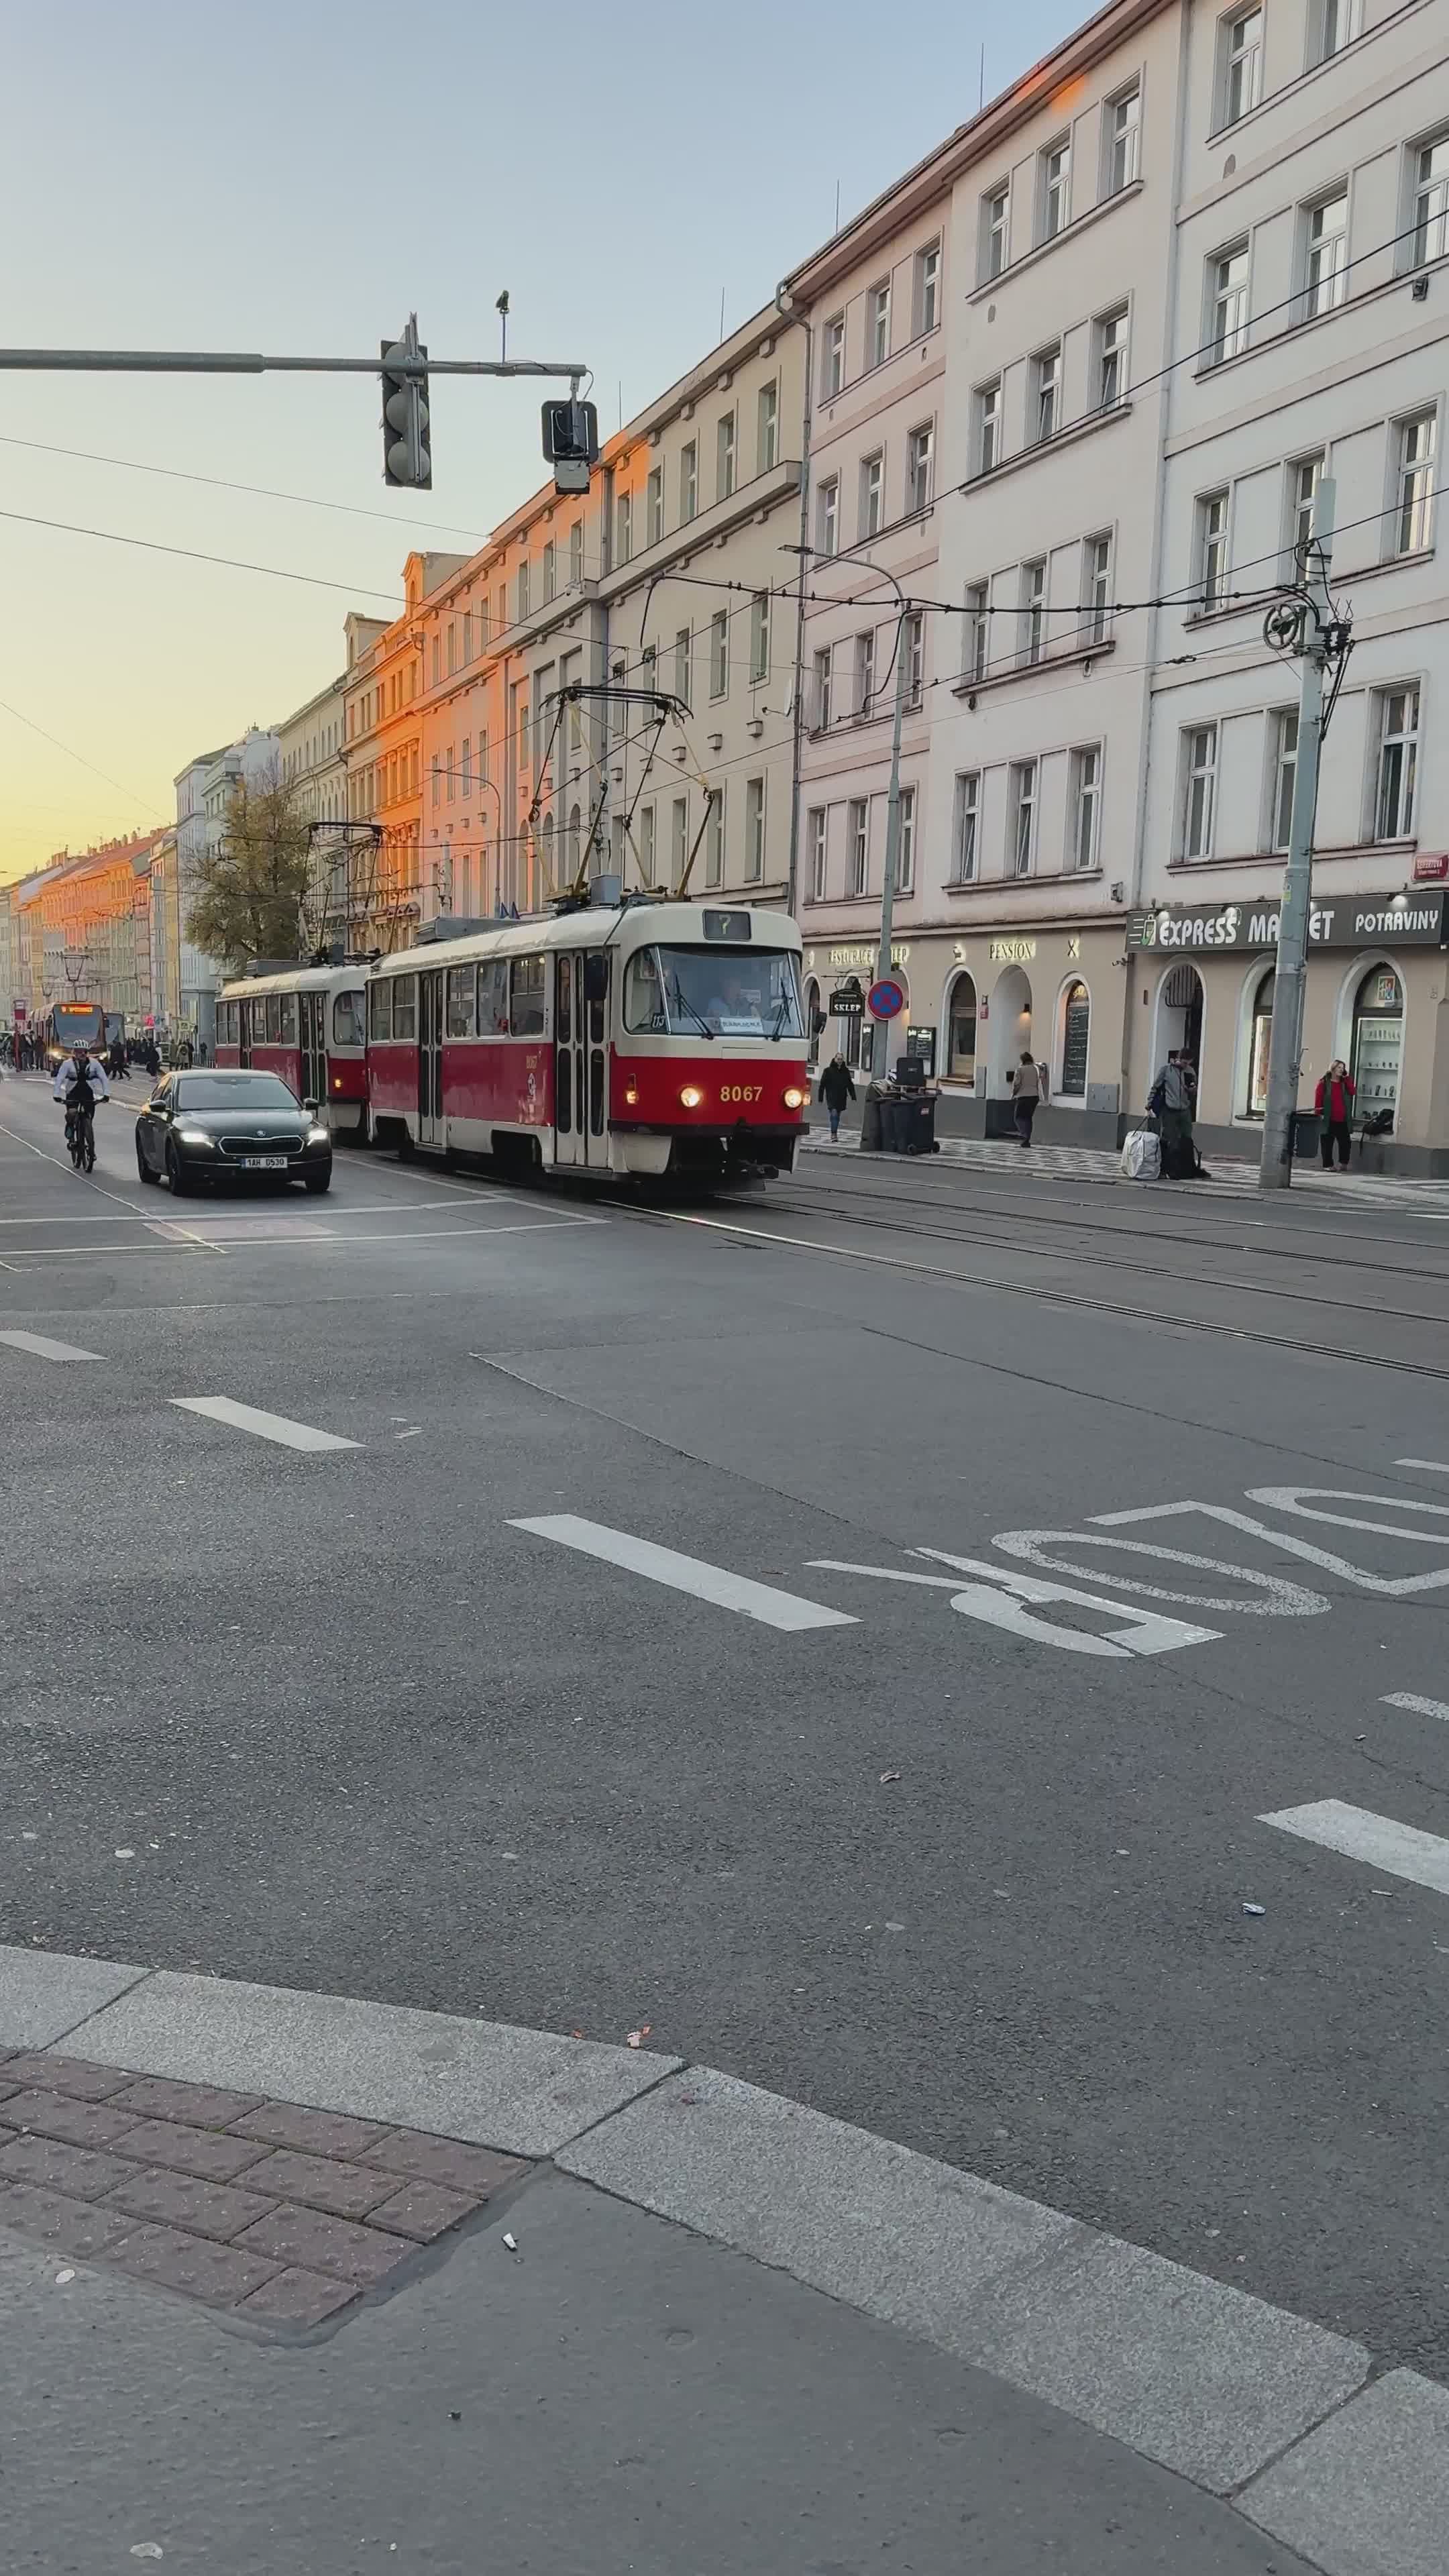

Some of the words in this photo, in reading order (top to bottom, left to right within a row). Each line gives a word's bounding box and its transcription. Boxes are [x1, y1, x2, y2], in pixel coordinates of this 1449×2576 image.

[718, 914, 731, 934] 7
[1159, 917, 1238, 946] EXPRESS
[1248, 911, 1335, 943] MAET
[1355, 910, 1439, 932] POTRAVINY
[989, 943, 1033, 959] PENSION
[834, 1004, 861, 1012] SKLEP
[720, 1086, 763, 1102] 8067
